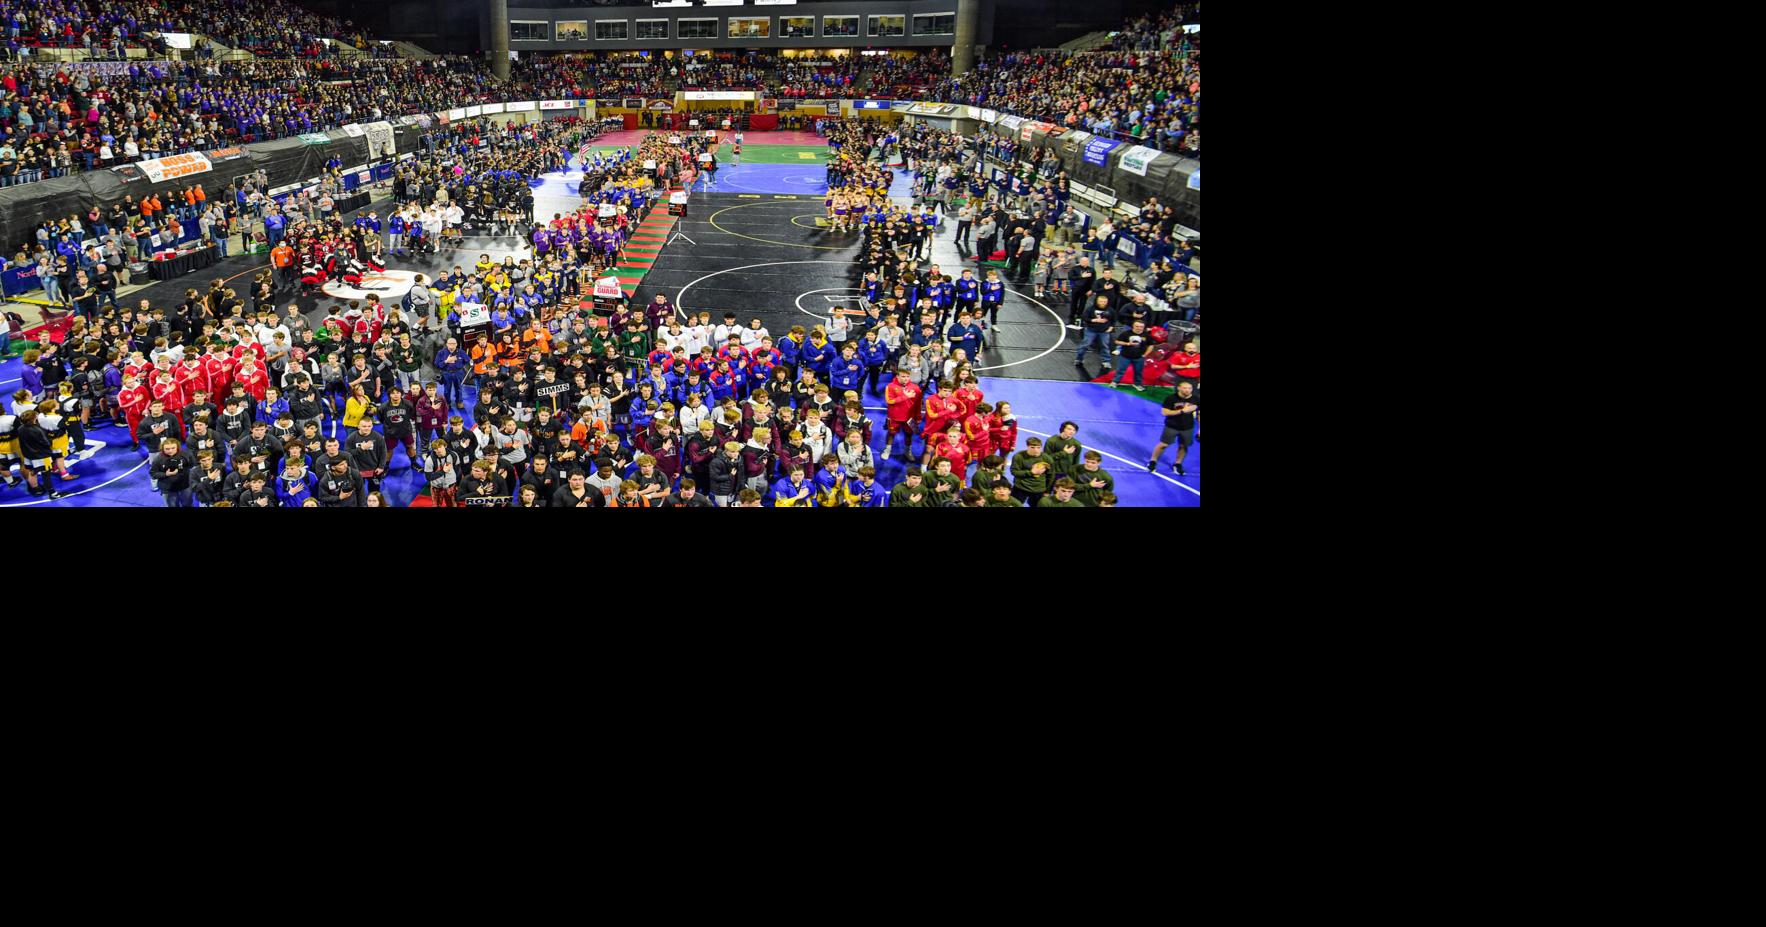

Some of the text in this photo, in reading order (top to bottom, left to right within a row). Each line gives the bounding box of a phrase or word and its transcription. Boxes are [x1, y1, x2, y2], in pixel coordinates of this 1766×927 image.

[597, 287, 619, 295] GUARD
[538, 383, 569, 396] SIMMS
[466, 496, 513, 505] RONAN
